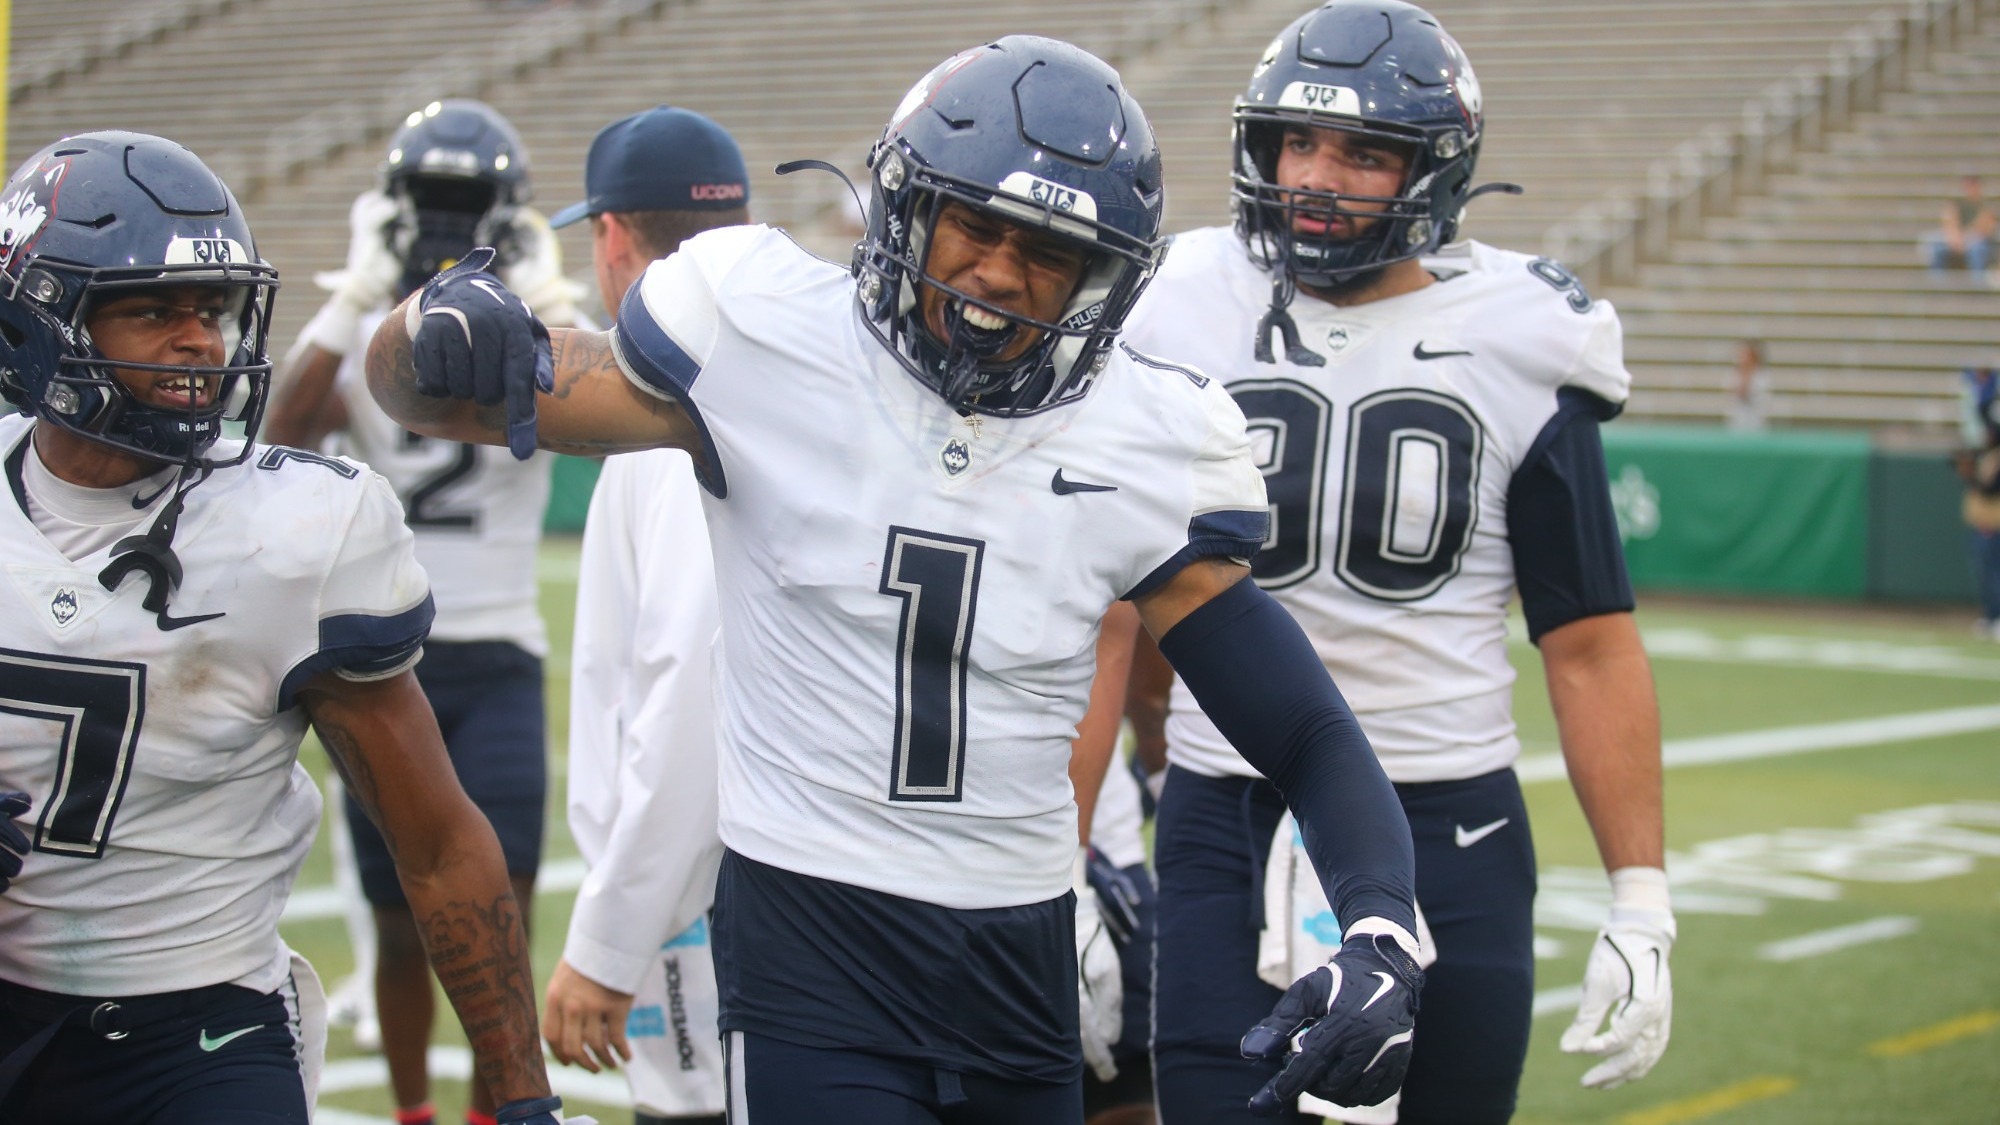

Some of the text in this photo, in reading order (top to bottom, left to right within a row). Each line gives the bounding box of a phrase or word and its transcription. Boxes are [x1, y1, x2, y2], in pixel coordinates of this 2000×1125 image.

[1526, 257, 1595, 315] 9
[256, 444, 360, 480] 7
[878, 524, 986, 803] 1
[0, 646, 147, 859] 7
